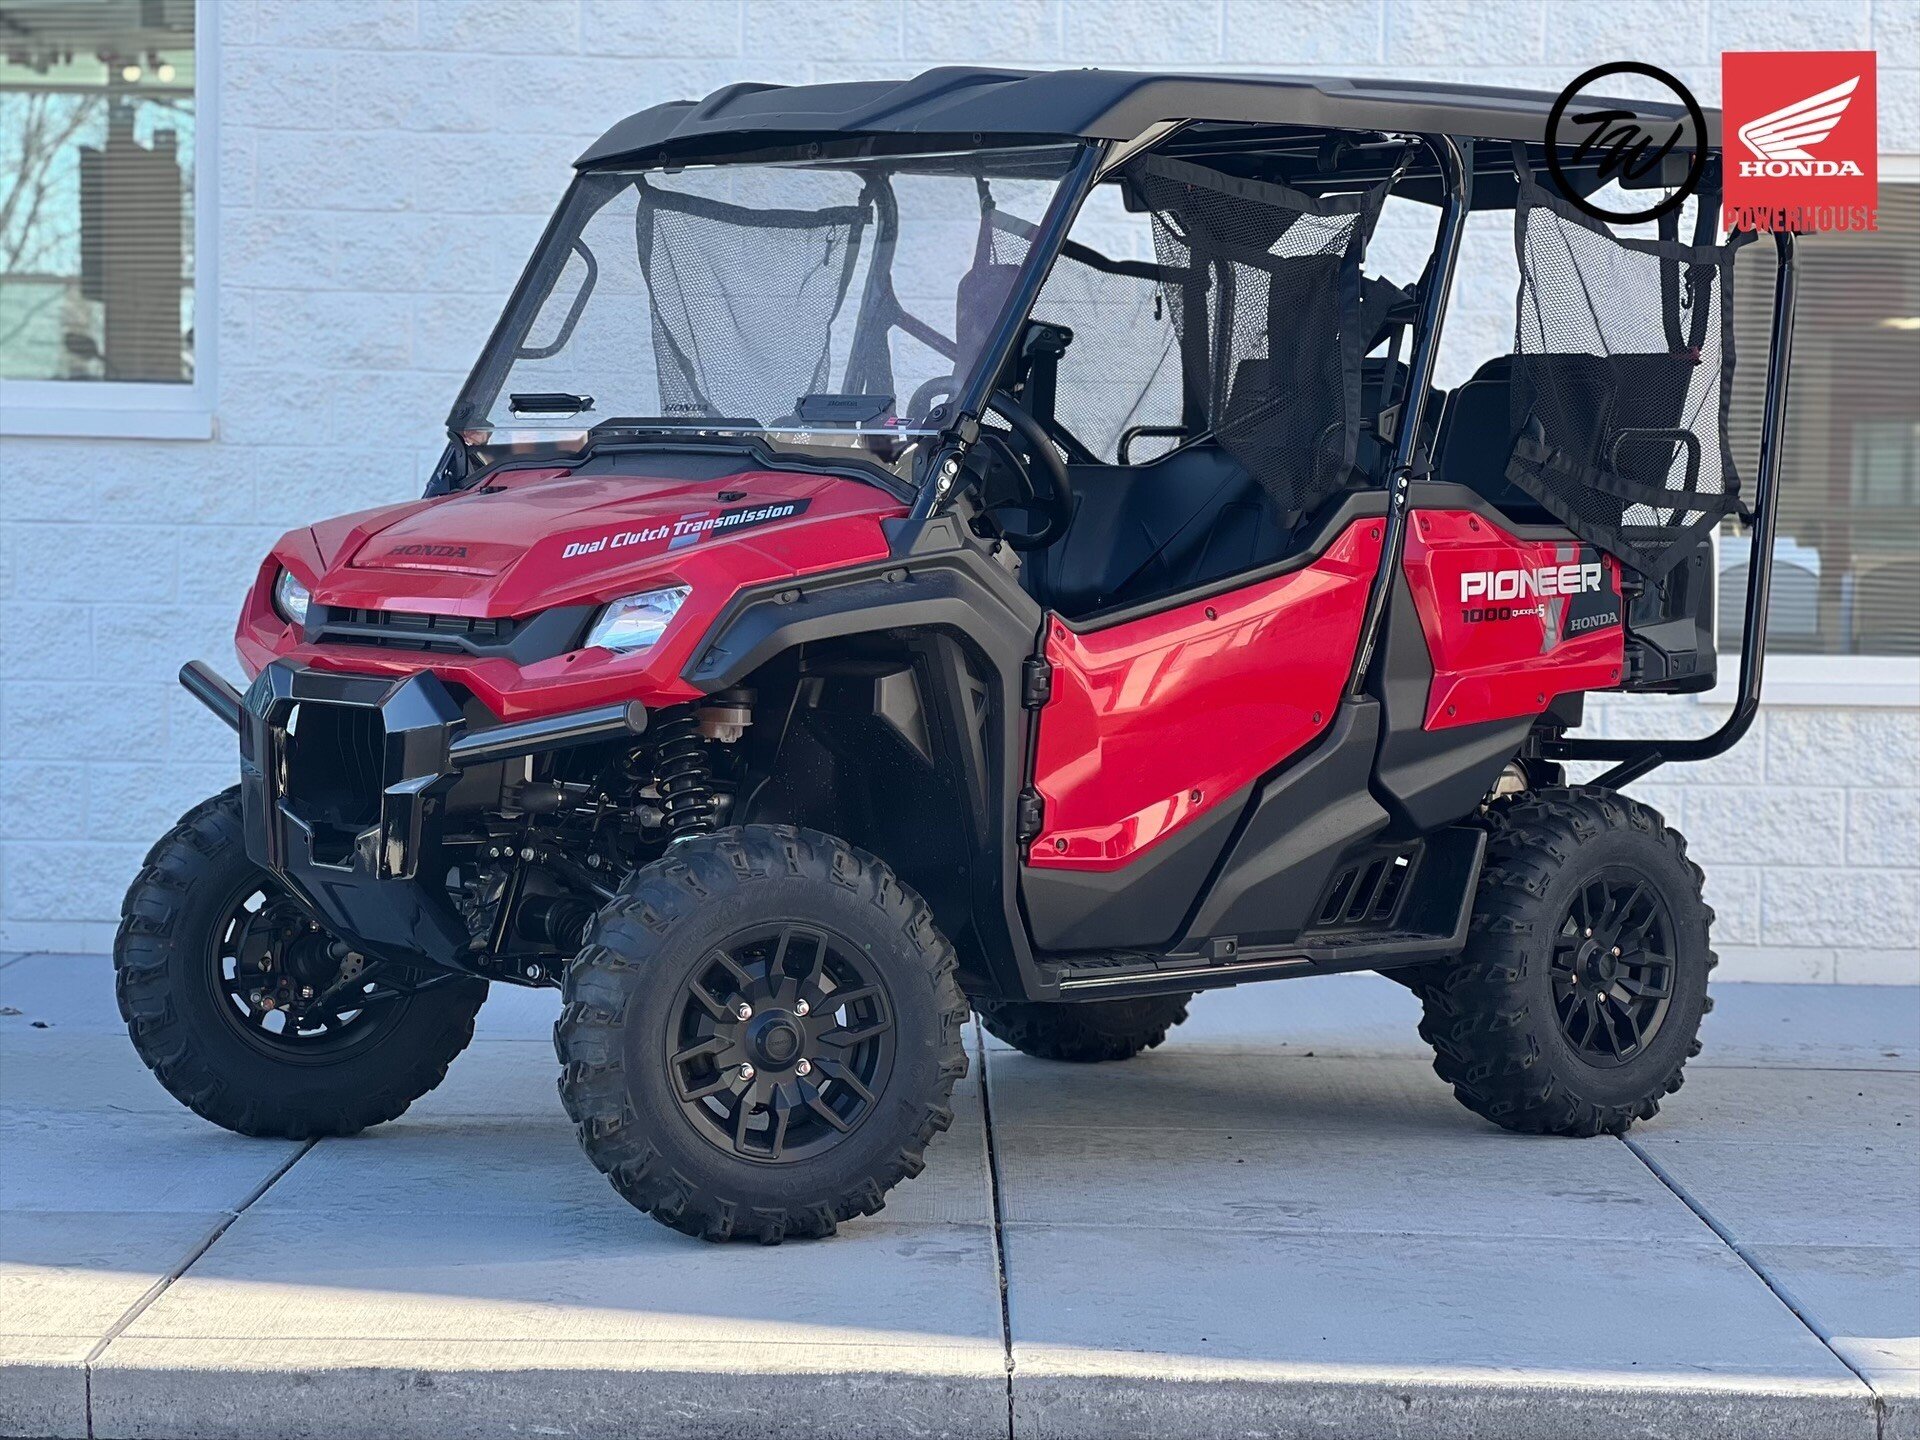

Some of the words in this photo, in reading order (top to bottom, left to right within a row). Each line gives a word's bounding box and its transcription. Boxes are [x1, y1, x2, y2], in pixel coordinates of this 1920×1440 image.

[562, 537, 607, 558] Dual
[610, 525, 669, 548] Clutch
[673, 504, 794, 536] Transmission
[386, 545, 467, 557] HONDA
[1461, 563, 1601, 602] PIONEER
[1570, 612, 1618, 631] HONDA
